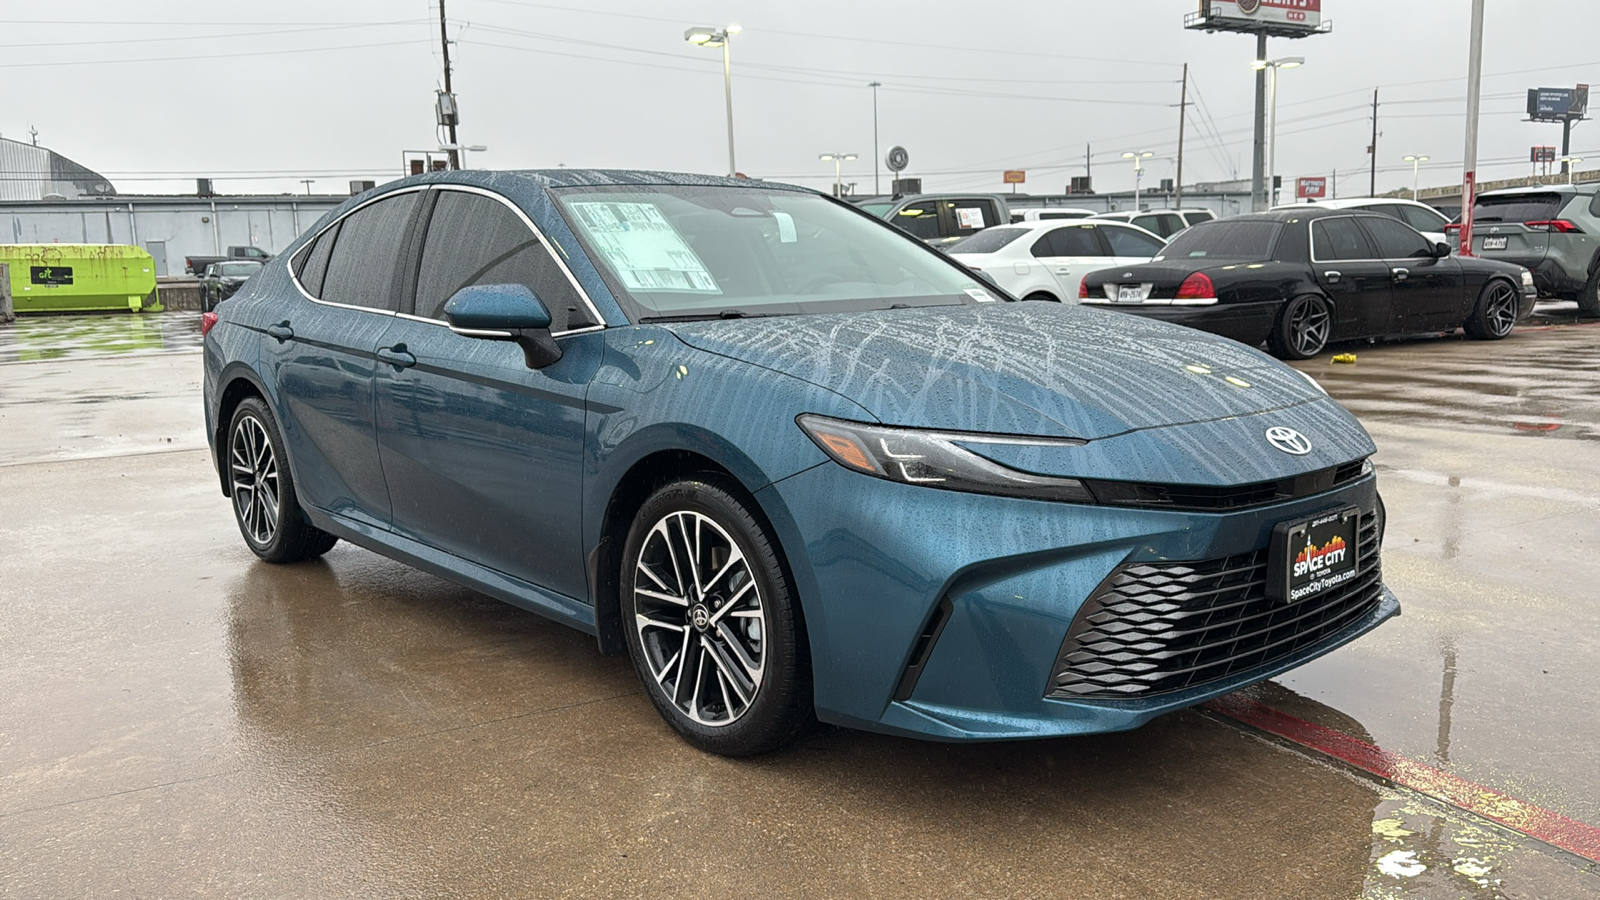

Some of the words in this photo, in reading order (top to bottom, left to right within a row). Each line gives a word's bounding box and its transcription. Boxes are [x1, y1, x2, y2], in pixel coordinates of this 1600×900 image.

[1294, 555, 1323, 577] SPACE
[1325, 548, 1346, 566] CITY
[1316, 568, 1331, 577] TOYOTA
[1291, 569, 1355, 600] SpaceCityToyota.com
